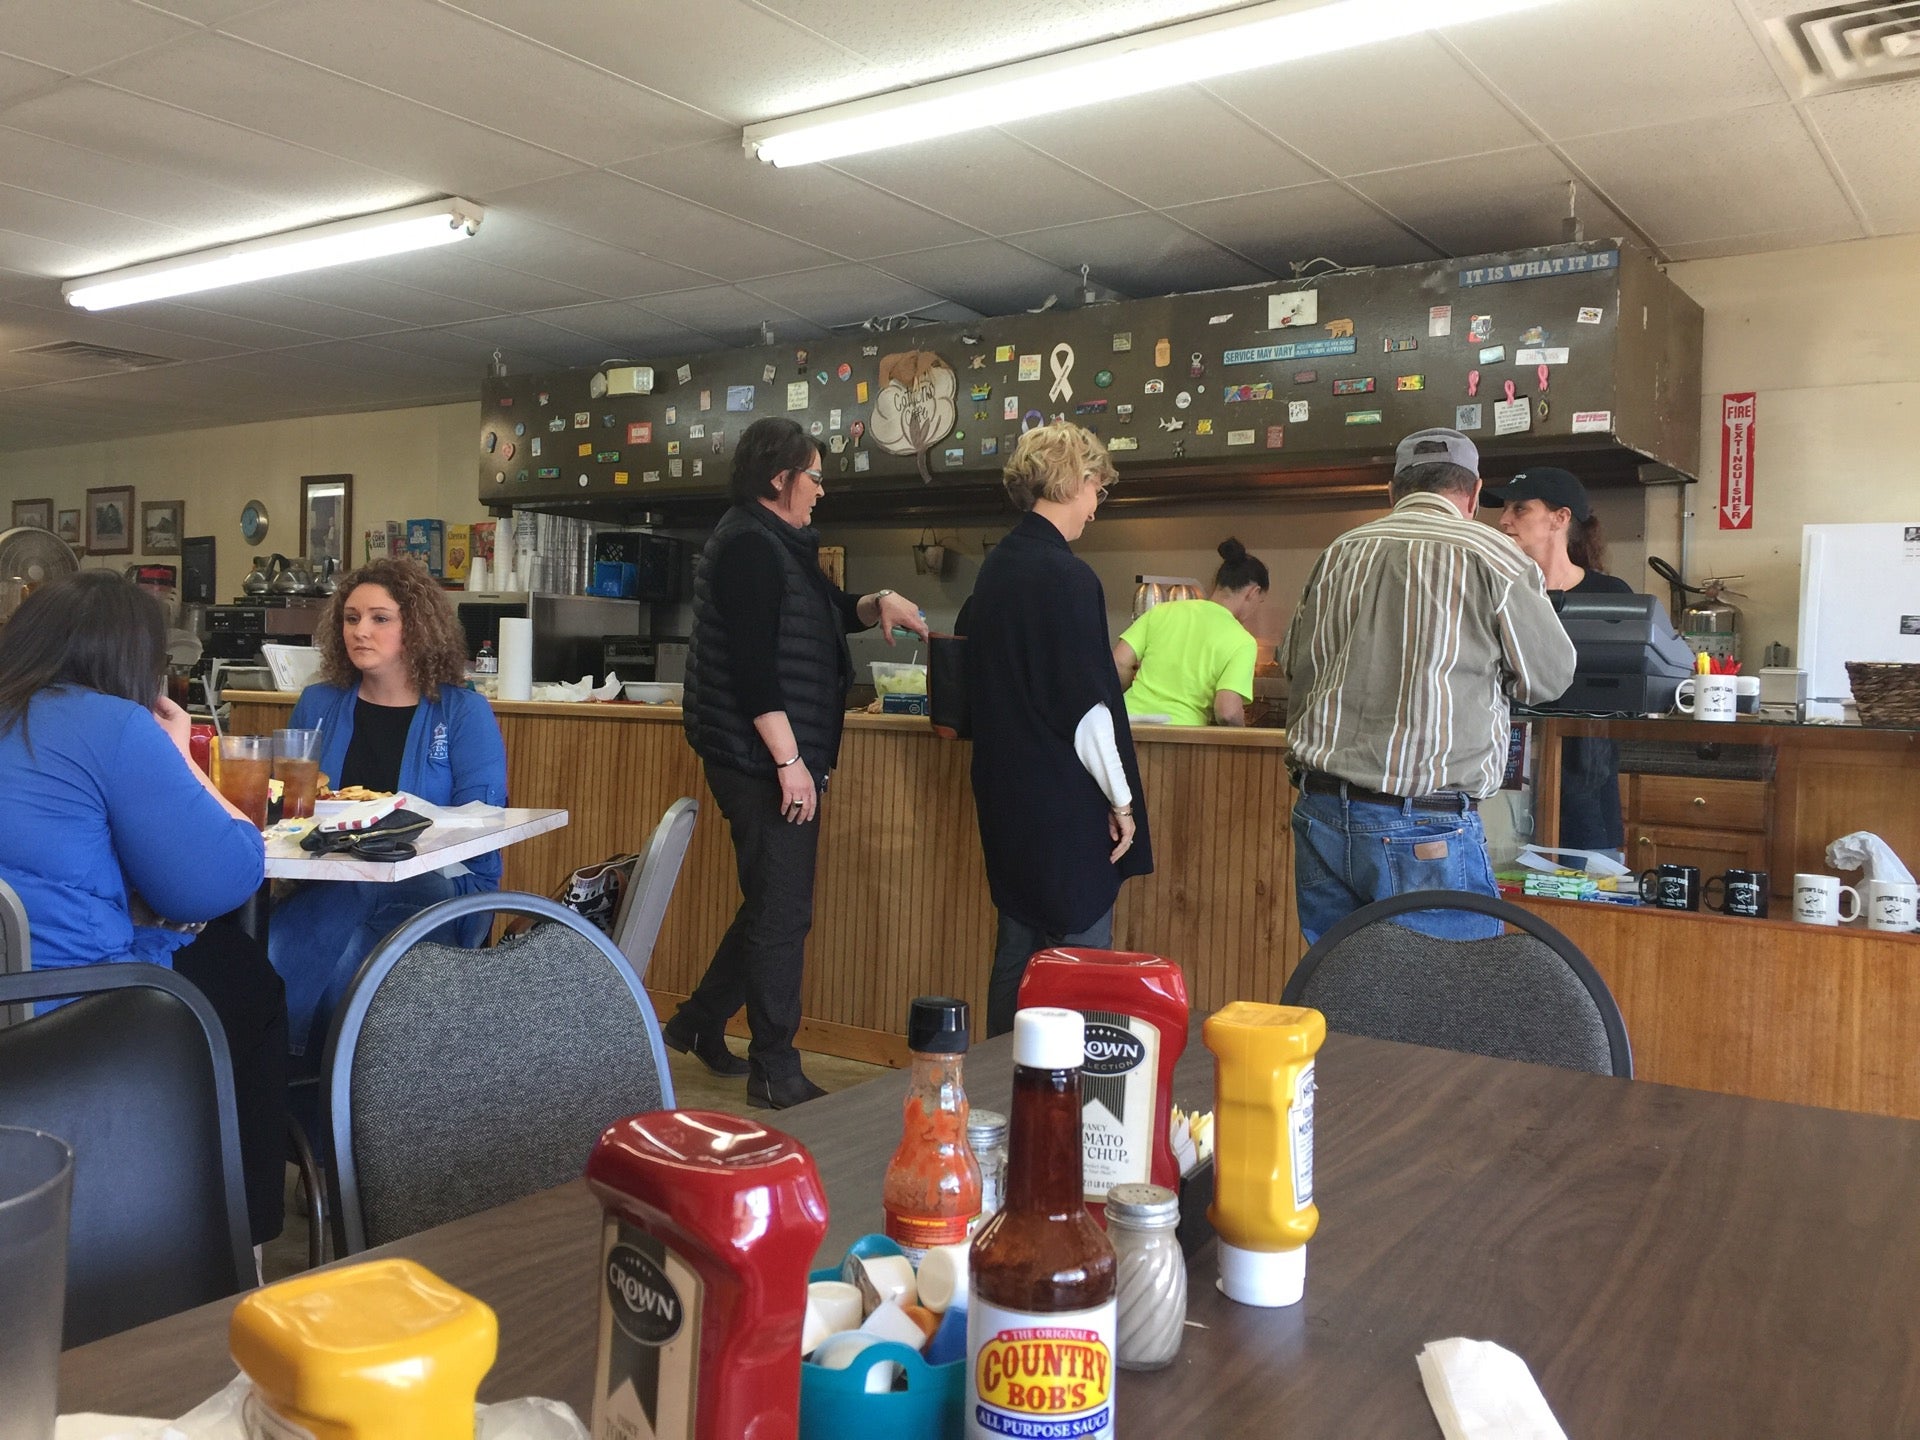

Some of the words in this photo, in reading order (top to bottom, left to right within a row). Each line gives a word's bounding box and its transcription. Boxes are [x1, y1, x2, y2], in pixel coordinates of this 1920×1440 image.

[1466, 270, 1484, 284] IT
[1487, 267, 1504, 281] IS
[1509, 258, 1563, 278] WHAT
[1567, 255, 1587, 271] IT
[1591, 253, 1609, 268] IS
[1226, 351, 1255, 362] SERVICE
[1257, 348, 1272, 359] MAY
[1274, 345, 1294, 358] VARY
[1727, 405, 1752, 419] FIRE
[1731, 423, 1743, 519] EXTINGUISHER
[1083, 1060, 1133, 1071] LECTION
[1083, 1132, 1124, 1148] MATO
[1083, 1146, 1128, 1162] CHUP
[609, 1262, 675, 1321] CROWN
[1011, 1329, 1032, 1340] THE
[1036, 1328, 1087, 1340] ORIGINAL
[983, 1343, 1108, 1396] COUNTRY
[1007, 1381, 1086, 1410] BOB'S
[979, 1410, 1001, 1427] ALL
[1002, 1421, 1070, 1438] PURPOSE
[1072, 1411, 1108, 1435] SAUCE
